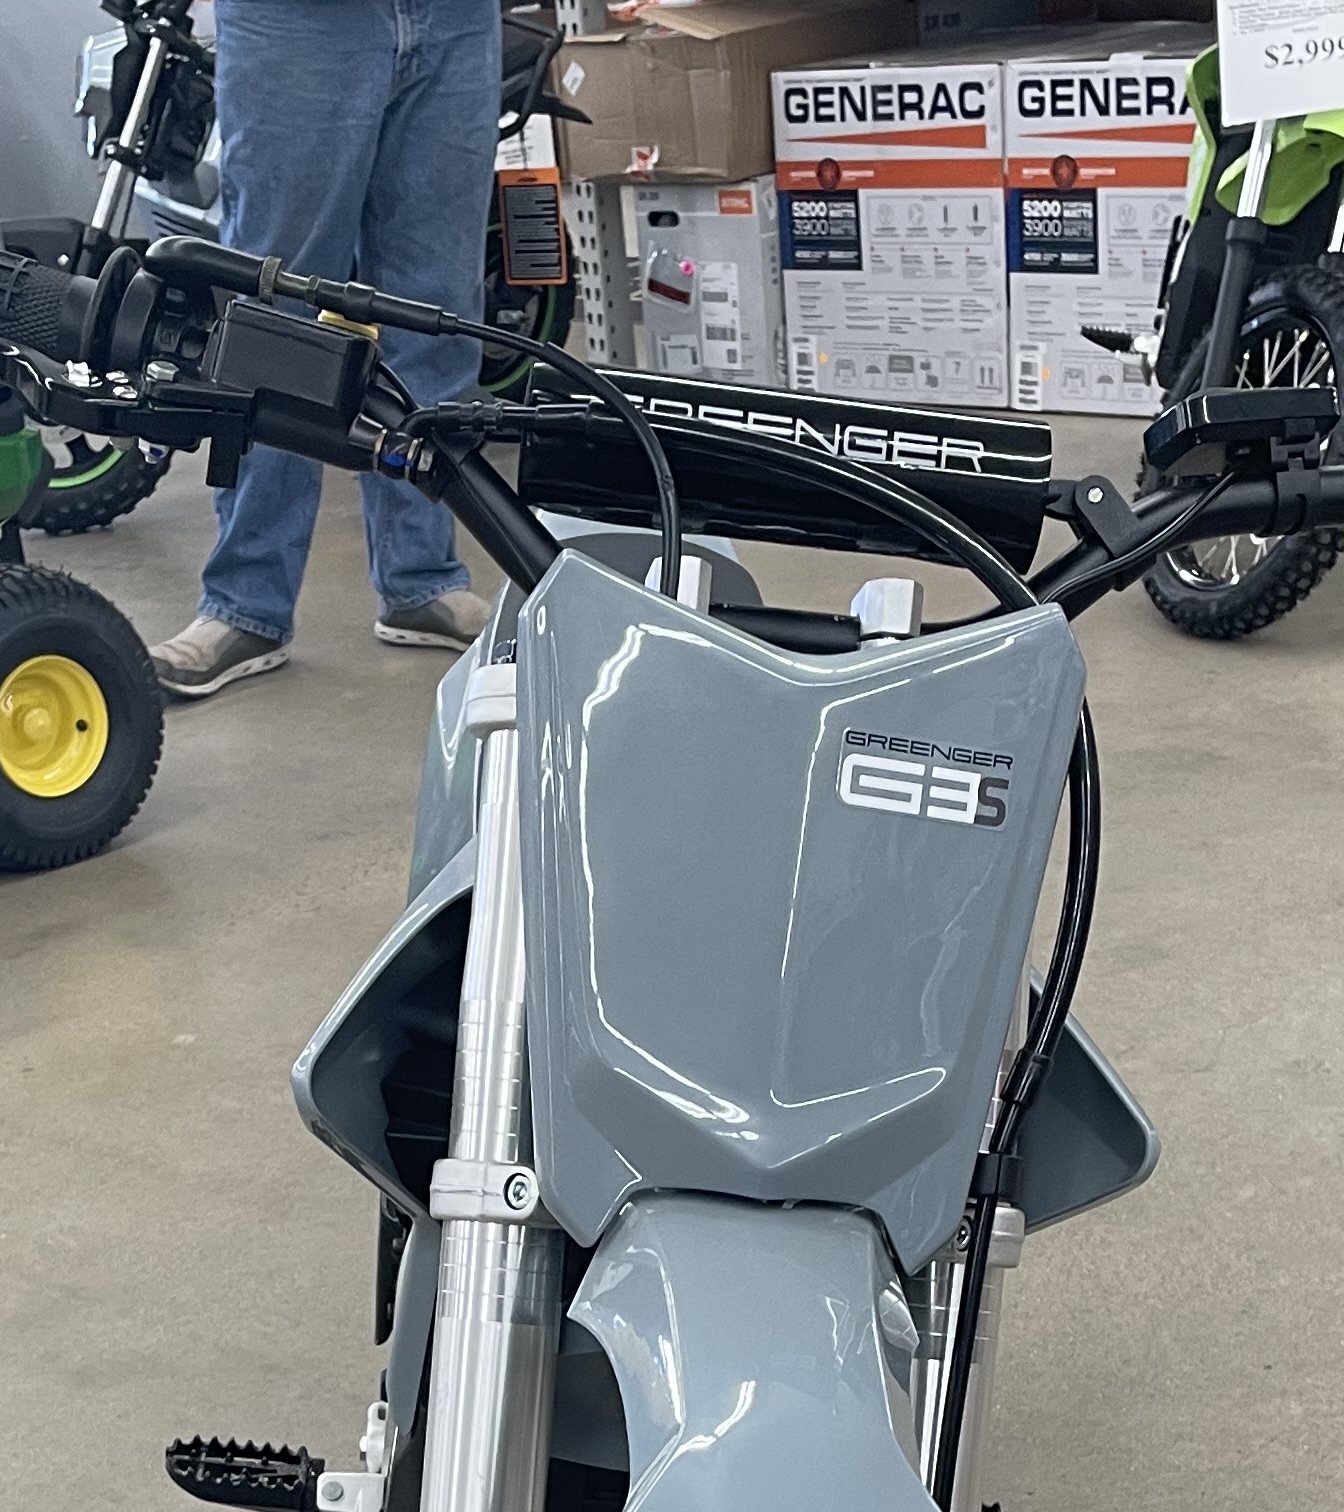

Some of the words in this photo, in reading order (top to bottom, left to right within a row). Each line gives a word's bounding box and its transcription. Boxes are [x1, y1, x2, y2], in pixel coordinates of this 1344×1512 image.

[784, 81, 987, 124] GENERAC
[1018, 76, 1192, 118] GENER
[1022, 200, 1061, 218] 5200
[1023, 219, 1062, 236] 3900
[624, 393, 983, 473] REENGER
[845, 730, 1013, 770] GREENGER
[839, 753, 1010, 827] G3S
